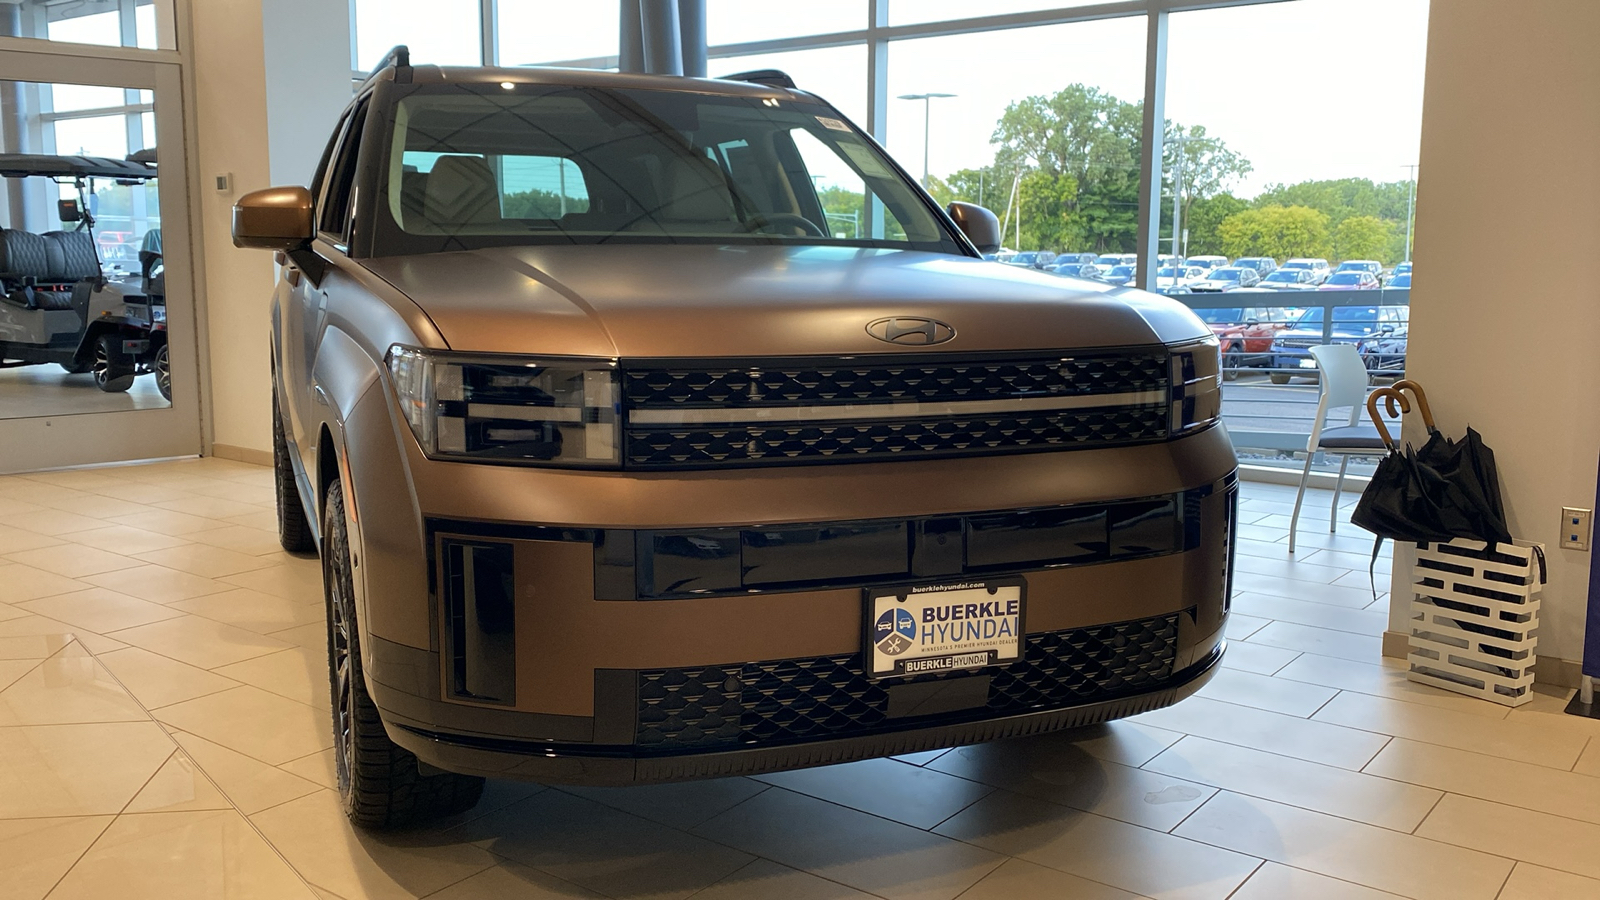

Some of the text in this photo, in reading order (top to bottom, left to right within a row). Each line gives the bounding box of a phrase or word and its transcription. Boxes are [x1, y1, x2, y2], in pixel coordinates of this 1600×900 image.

[912, 582, 985, 593] buerklehyundai.com
[922, 600, 1018, 623] BUERKLE
[921, 617, 1018, 645] HYUNDAI
[907, 654, 987, 672] BUERKLE HYUNDAI
